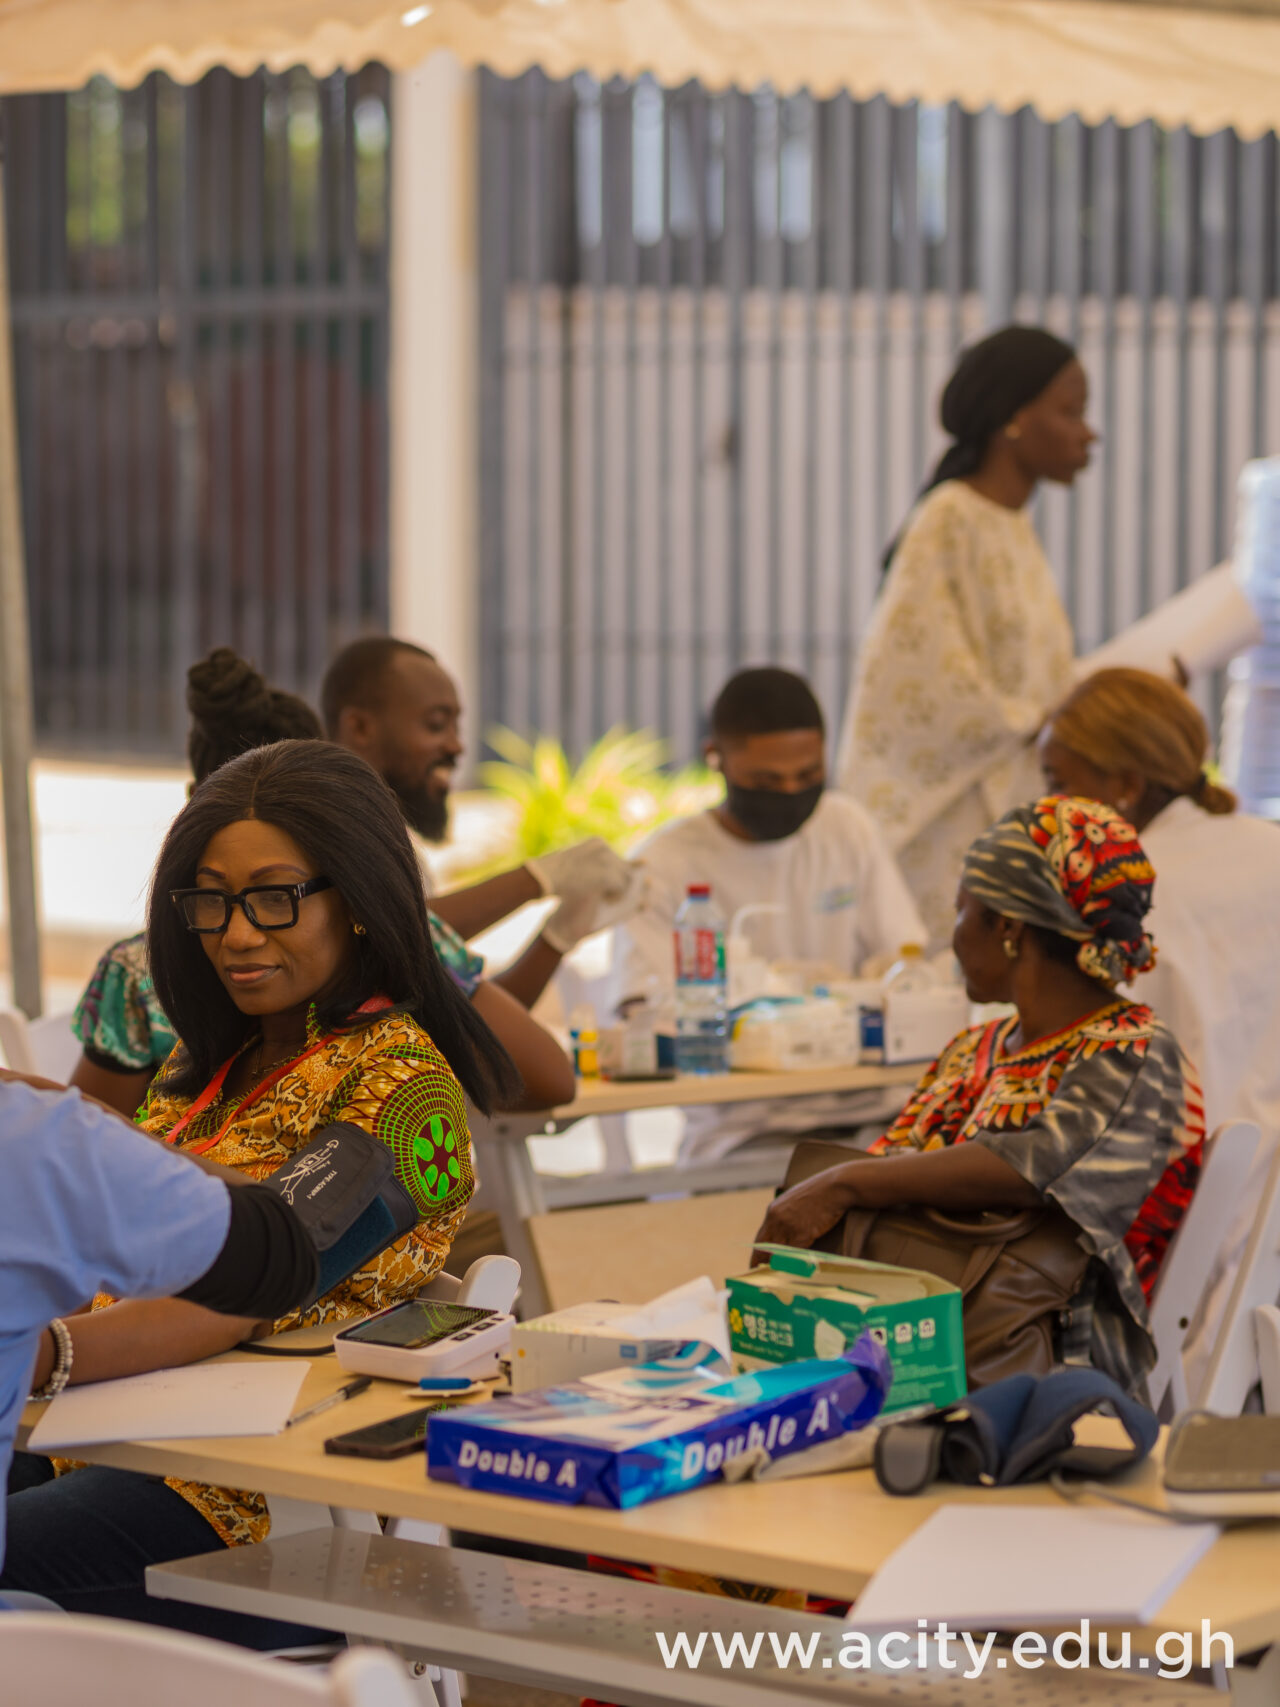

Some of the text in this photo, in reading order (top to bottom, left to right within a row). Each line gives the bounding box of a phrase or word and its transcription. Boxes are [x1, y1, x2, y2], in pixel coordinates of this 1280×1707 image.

[458, 1439, 577, 1489] Double A
[680, 1413, 798, 1482] Double
